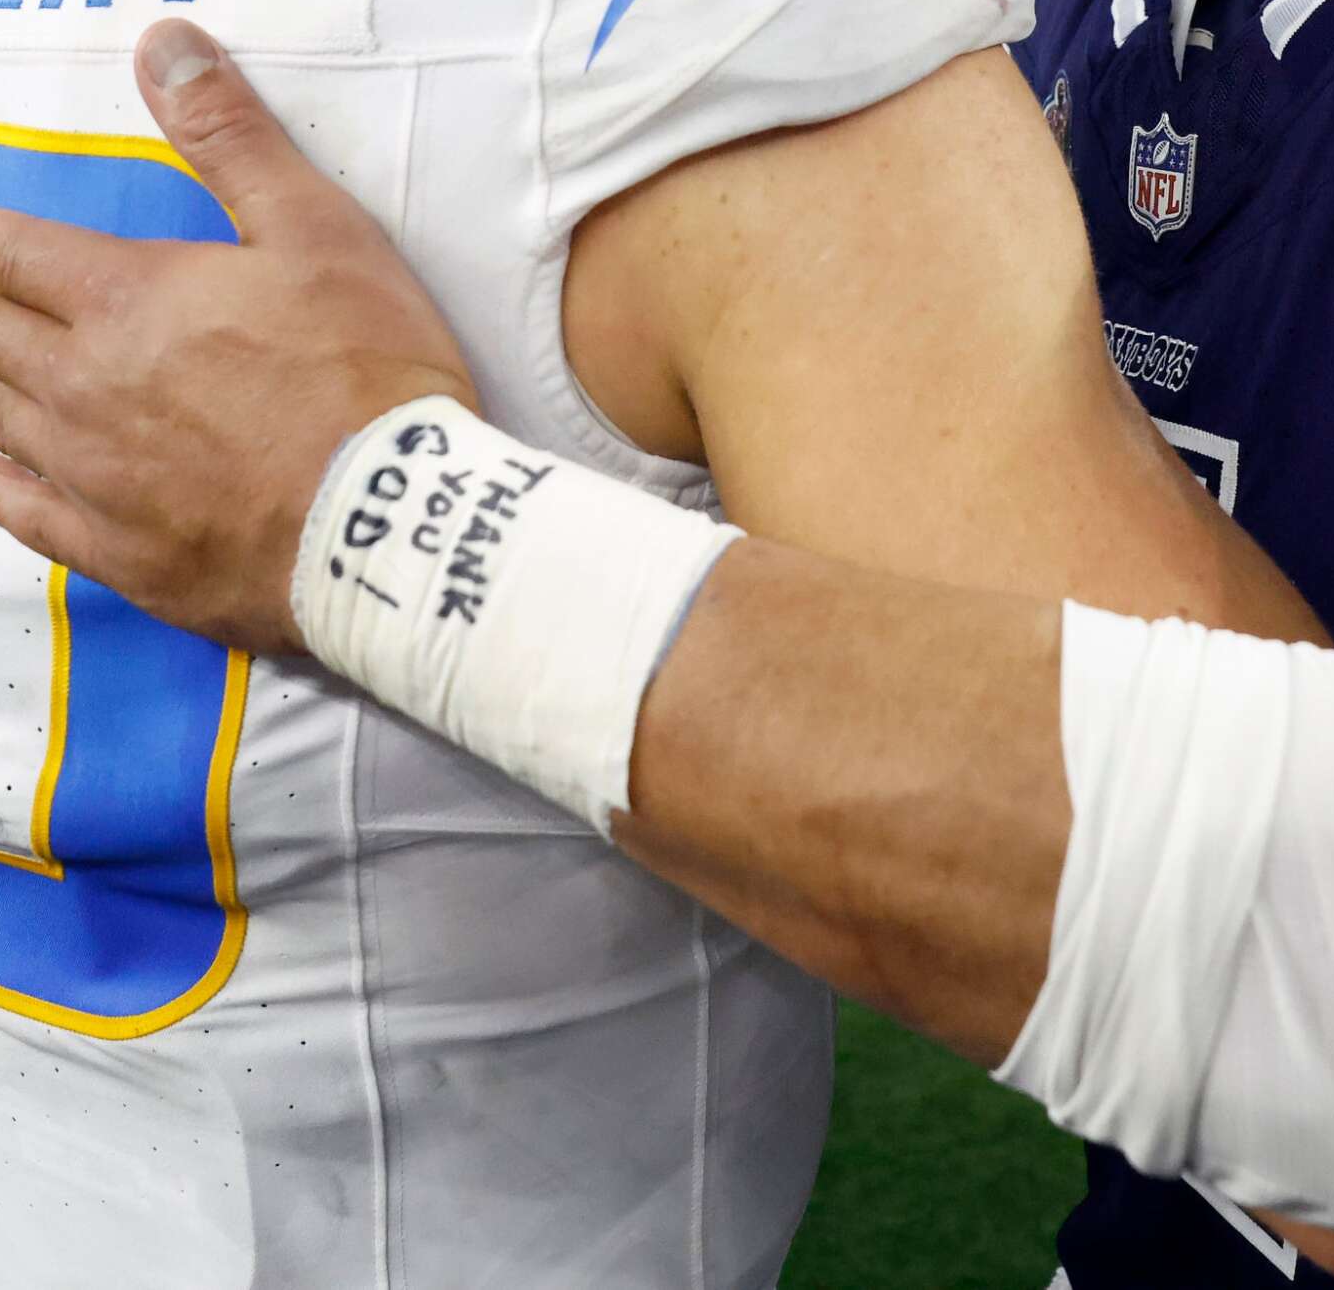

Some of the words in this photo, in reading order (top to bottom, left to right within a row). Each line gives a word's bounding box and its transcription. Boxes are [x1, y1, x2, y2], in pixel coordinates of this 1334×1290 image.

[1135, 170, 1180, 217] NFL
[1103, 320, 1199, 392] WBOYS
[330, 423, 451, 609] GOD!
[411, 469, 473, 555] YOU
[438, 458, 556, 625] THANK
